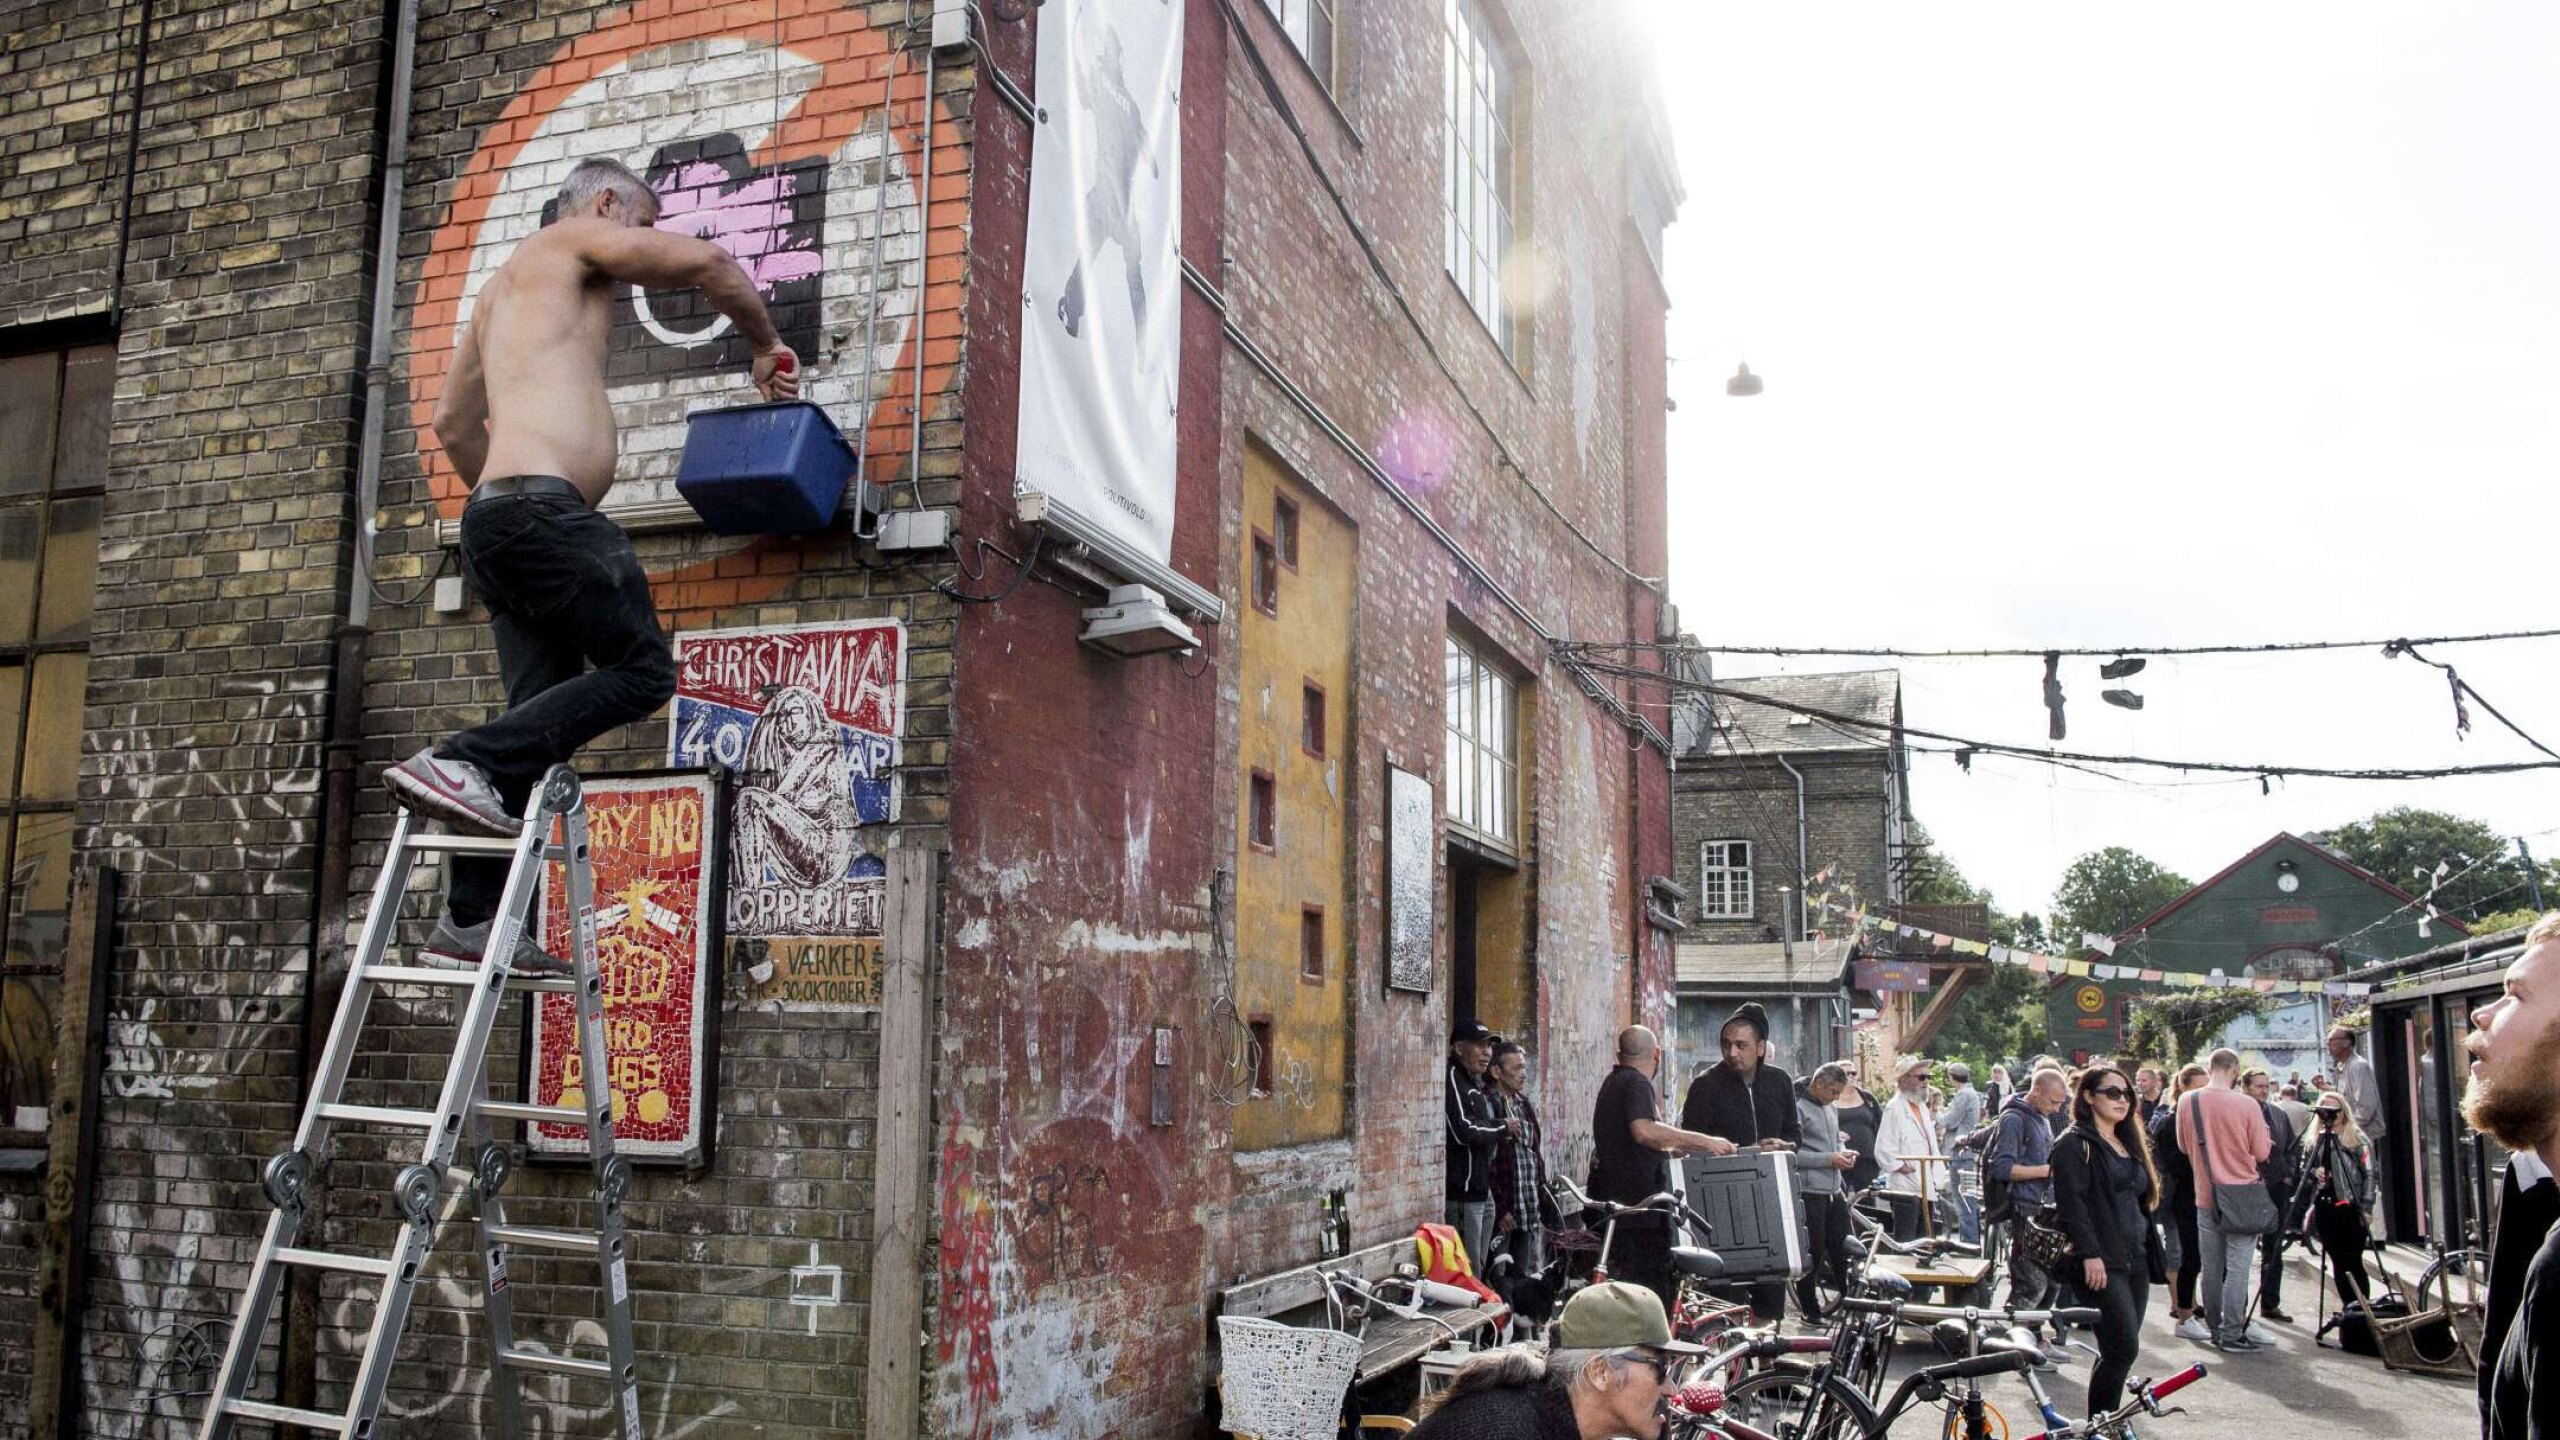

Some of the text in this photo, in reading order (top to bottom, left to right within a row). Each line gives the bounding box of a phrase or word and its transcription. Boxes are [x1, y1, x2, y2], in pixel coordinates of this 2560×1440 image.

[681, 707, 742, 768] 40
[650, 797, 699, 857] NO
[573, 1017, 653, 1051] RD
[562, 1052, 661, 1090] DUGS
